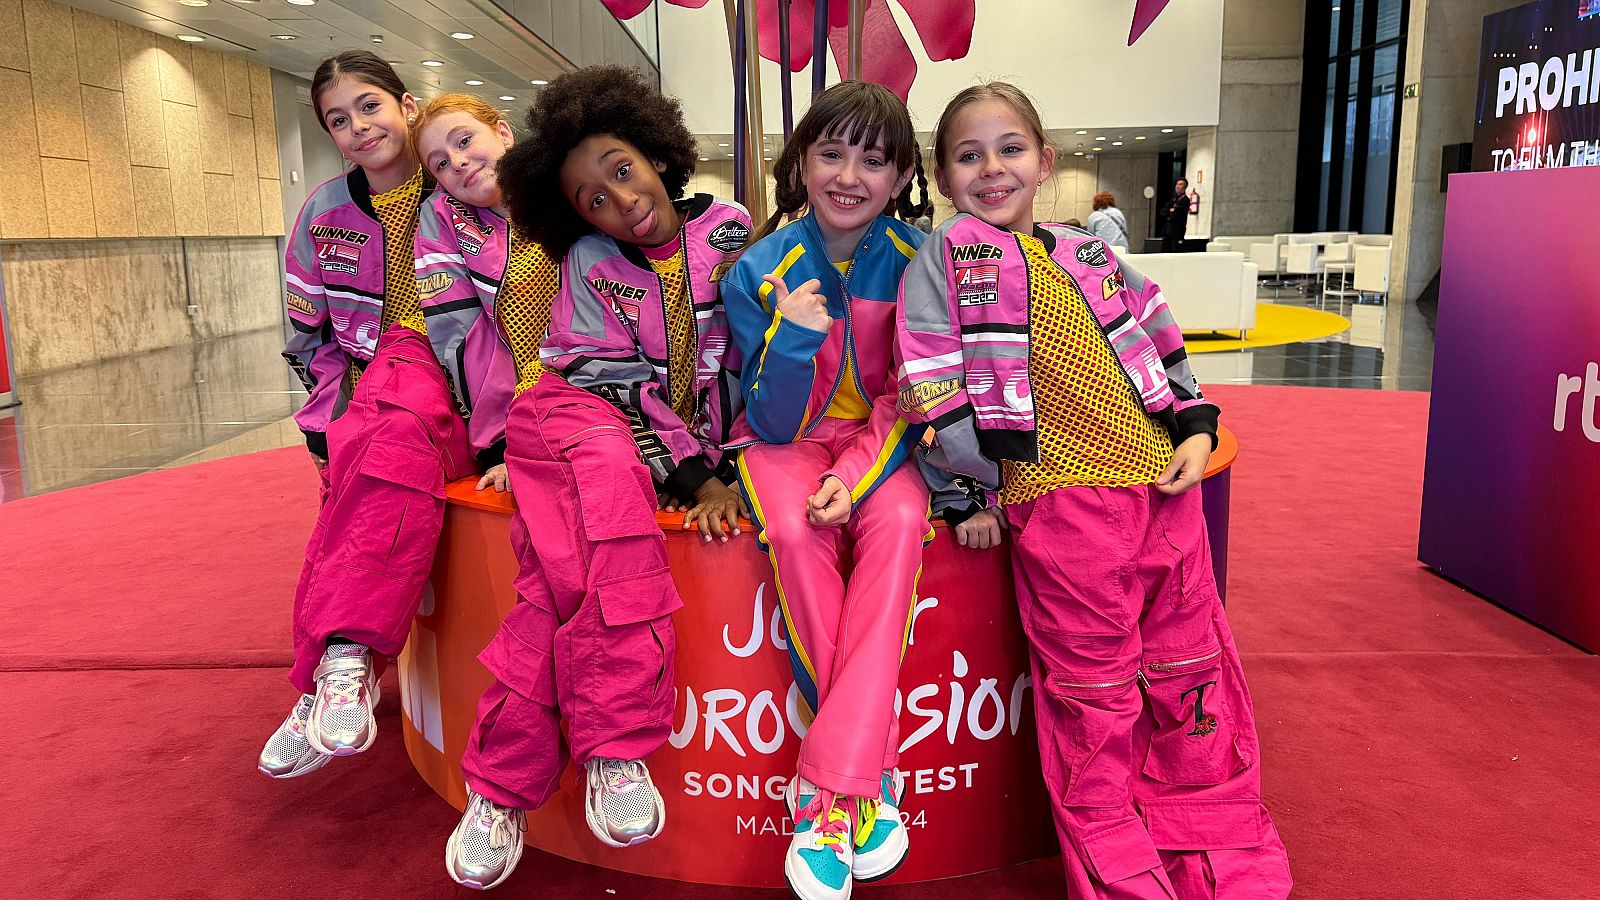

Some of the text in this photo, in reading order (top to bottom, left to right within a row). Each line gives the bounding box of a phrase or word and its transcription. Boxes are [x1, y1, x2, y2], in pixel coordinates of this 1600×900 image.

[310, 225, 371, 247] WINNER
[318, 244, 337, 259] LA
[951, 243, 1004, 262] INNER
[683, 771, 788, 801] SONG
[737, 809, 928, 836] MAD 24
